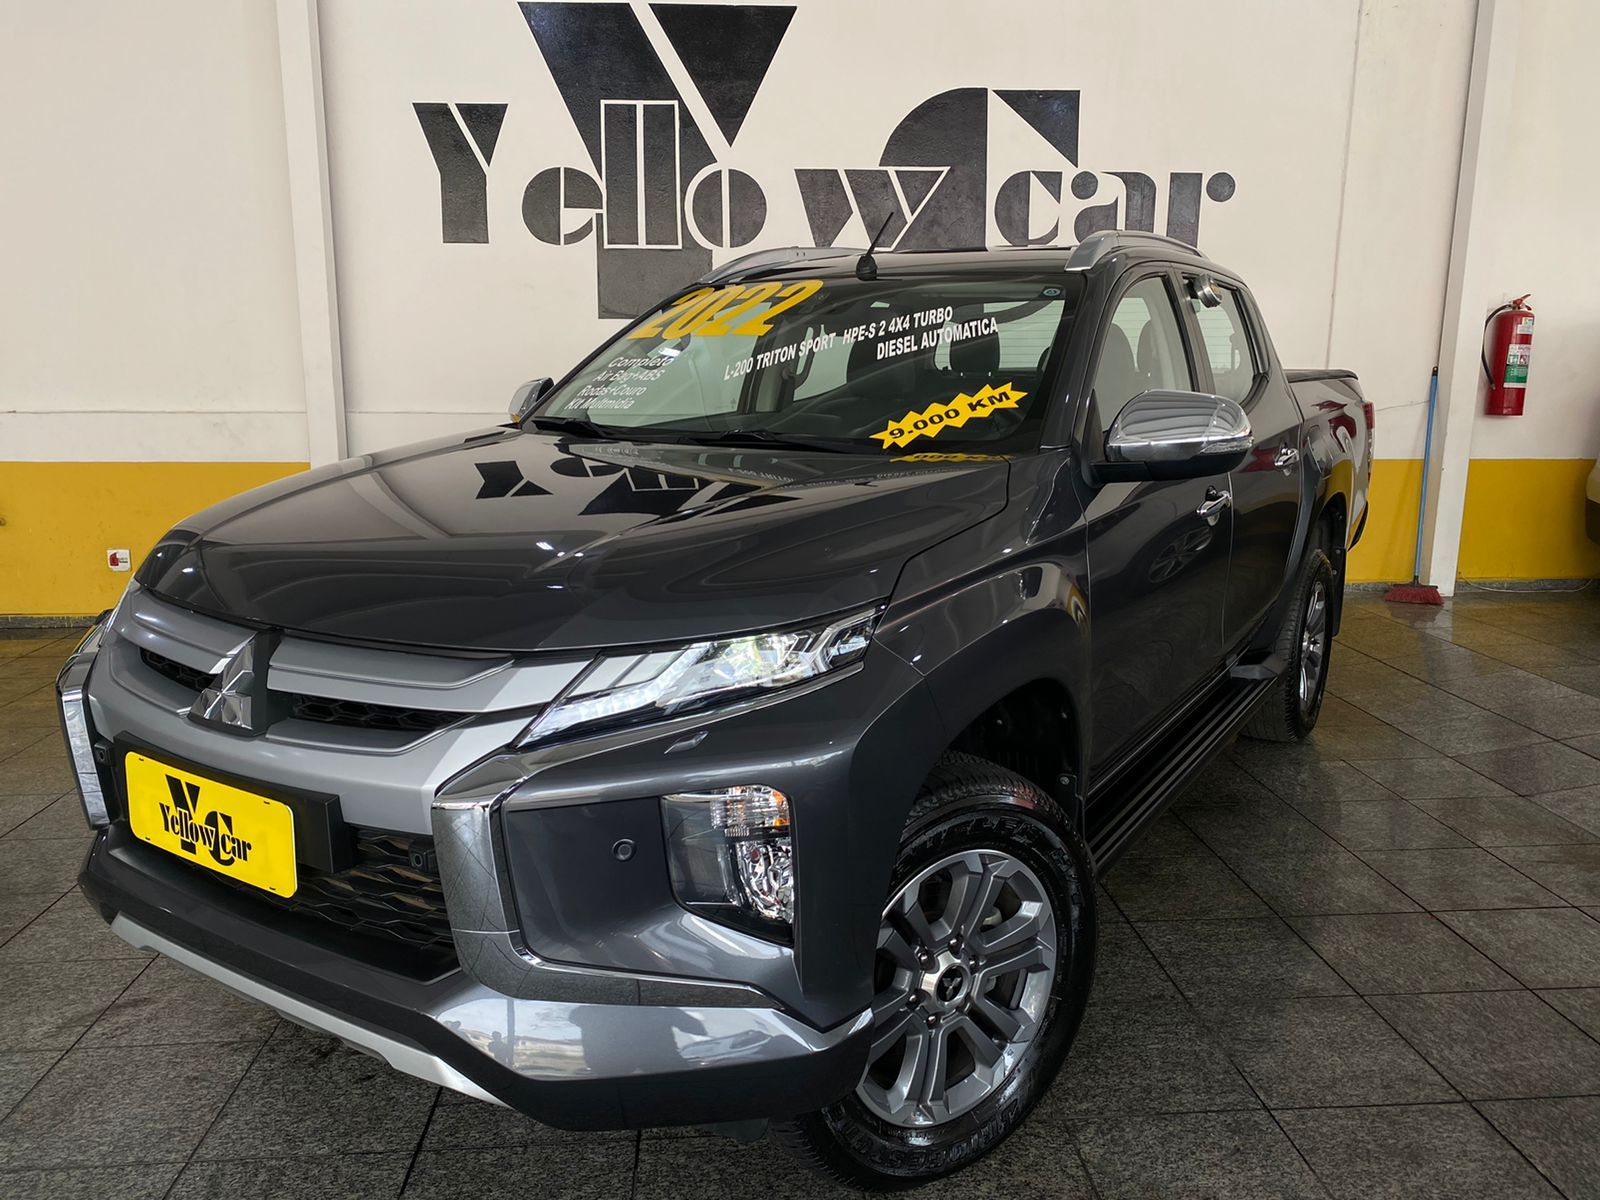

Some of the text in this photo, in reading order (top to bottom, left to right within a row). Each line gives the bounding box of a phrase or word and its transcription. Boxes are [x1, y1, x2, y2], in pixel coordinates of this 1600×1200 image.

[411, 101, 1237, 250] Yellow car
[626, 279, 825, 341] 2022
[608, 355, 675, 370] Completo
[723, 305, 954, 380] L-200 TRITON SPORT HPE-S 2 4X4 TURBO
[876, 316, 999, 361] DIESEL AUTOMATICA
[889, 391, 1011, 439] 9.000 KM
[159, 802, 216, 851] Yellow
